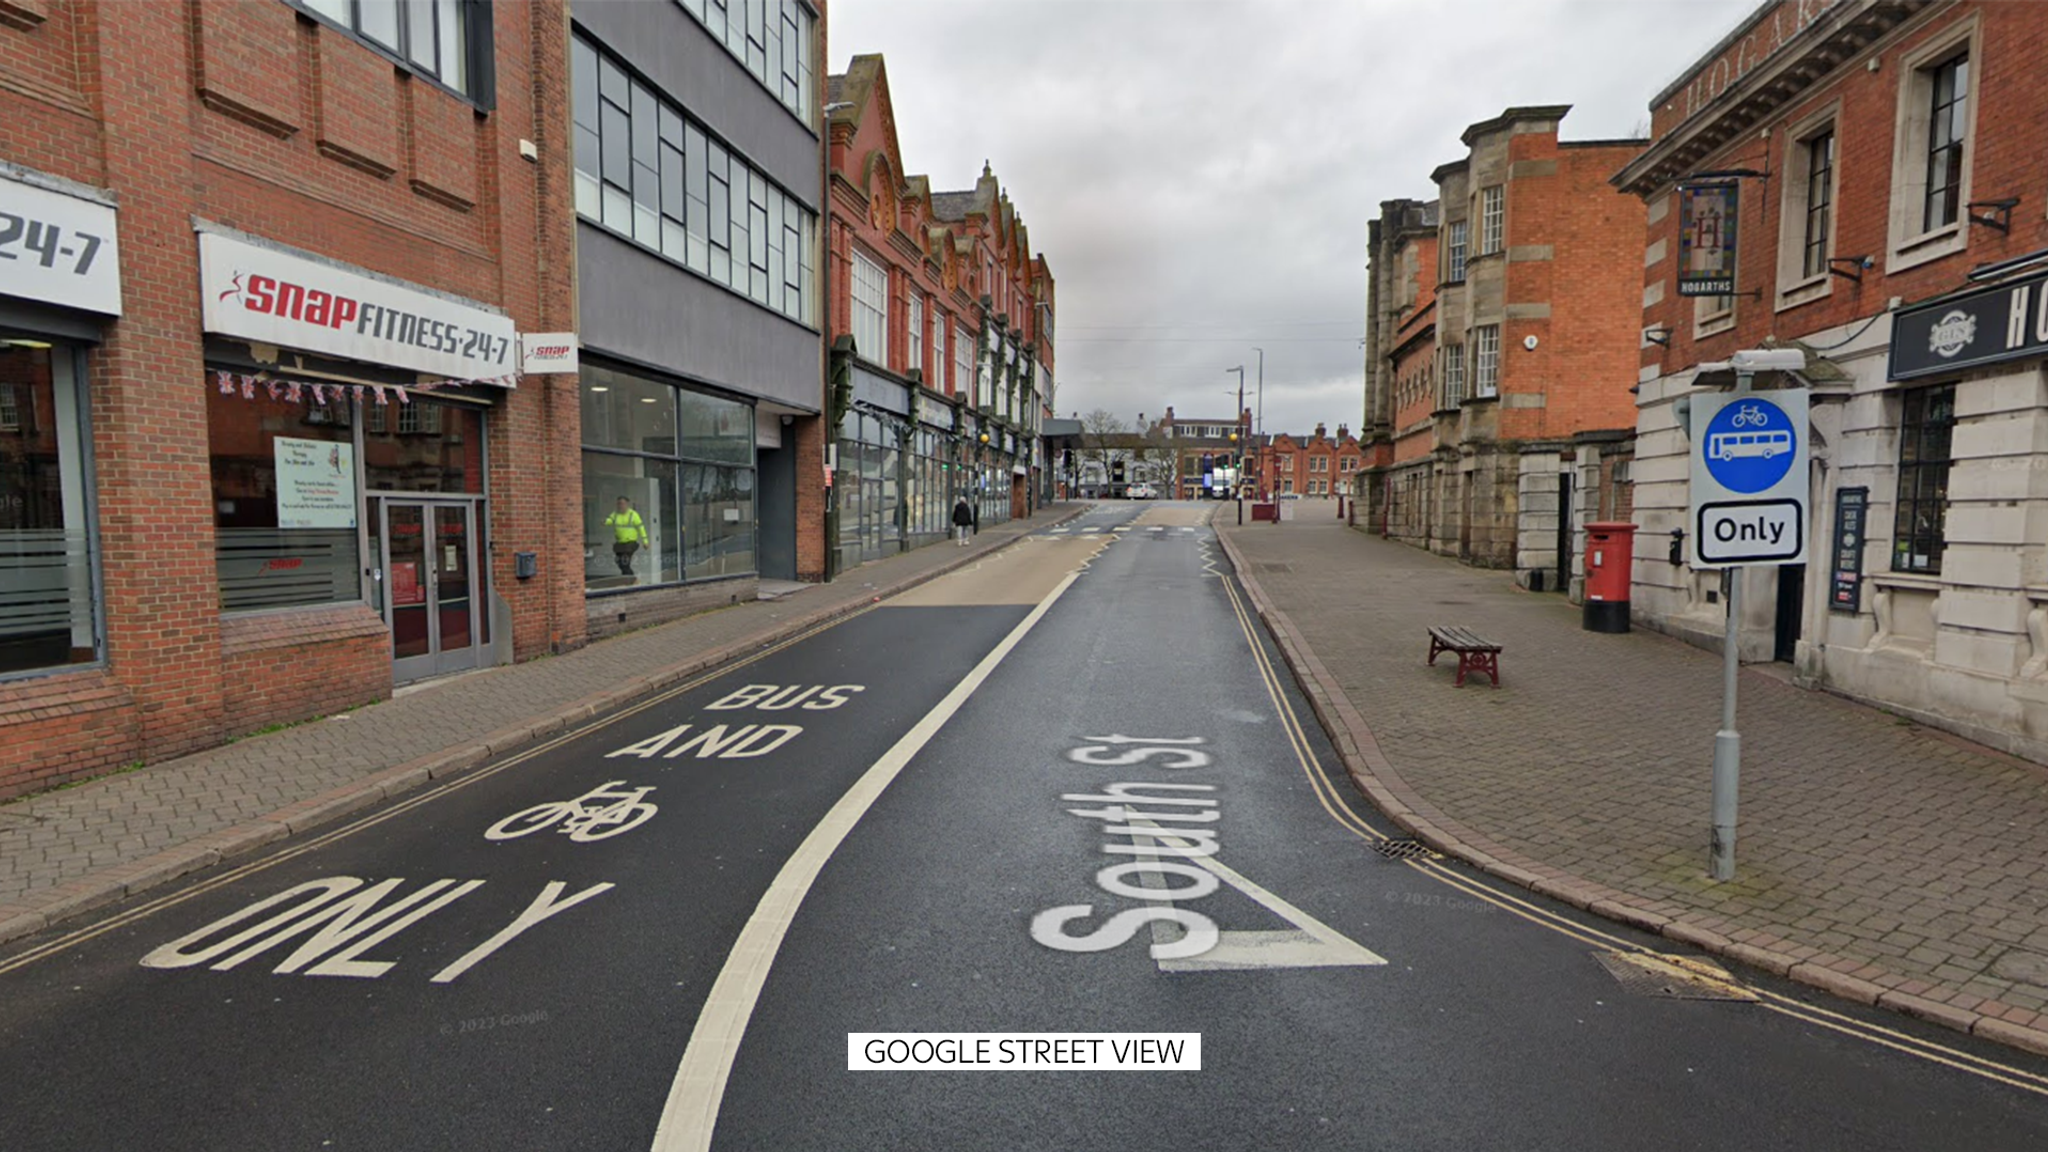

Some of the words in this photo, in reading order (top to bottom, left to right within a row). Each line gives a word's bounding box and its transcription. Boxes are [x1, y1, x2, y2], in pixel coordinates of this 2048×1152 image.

[1682, 282, 1731, 293] HOGARTHS
[1714, 516, 1785, 544] Only
[703, 685, 865, 710] BUS
[603, 724, 804, 759] AND
[139, 876, 616, 983] ONLY
